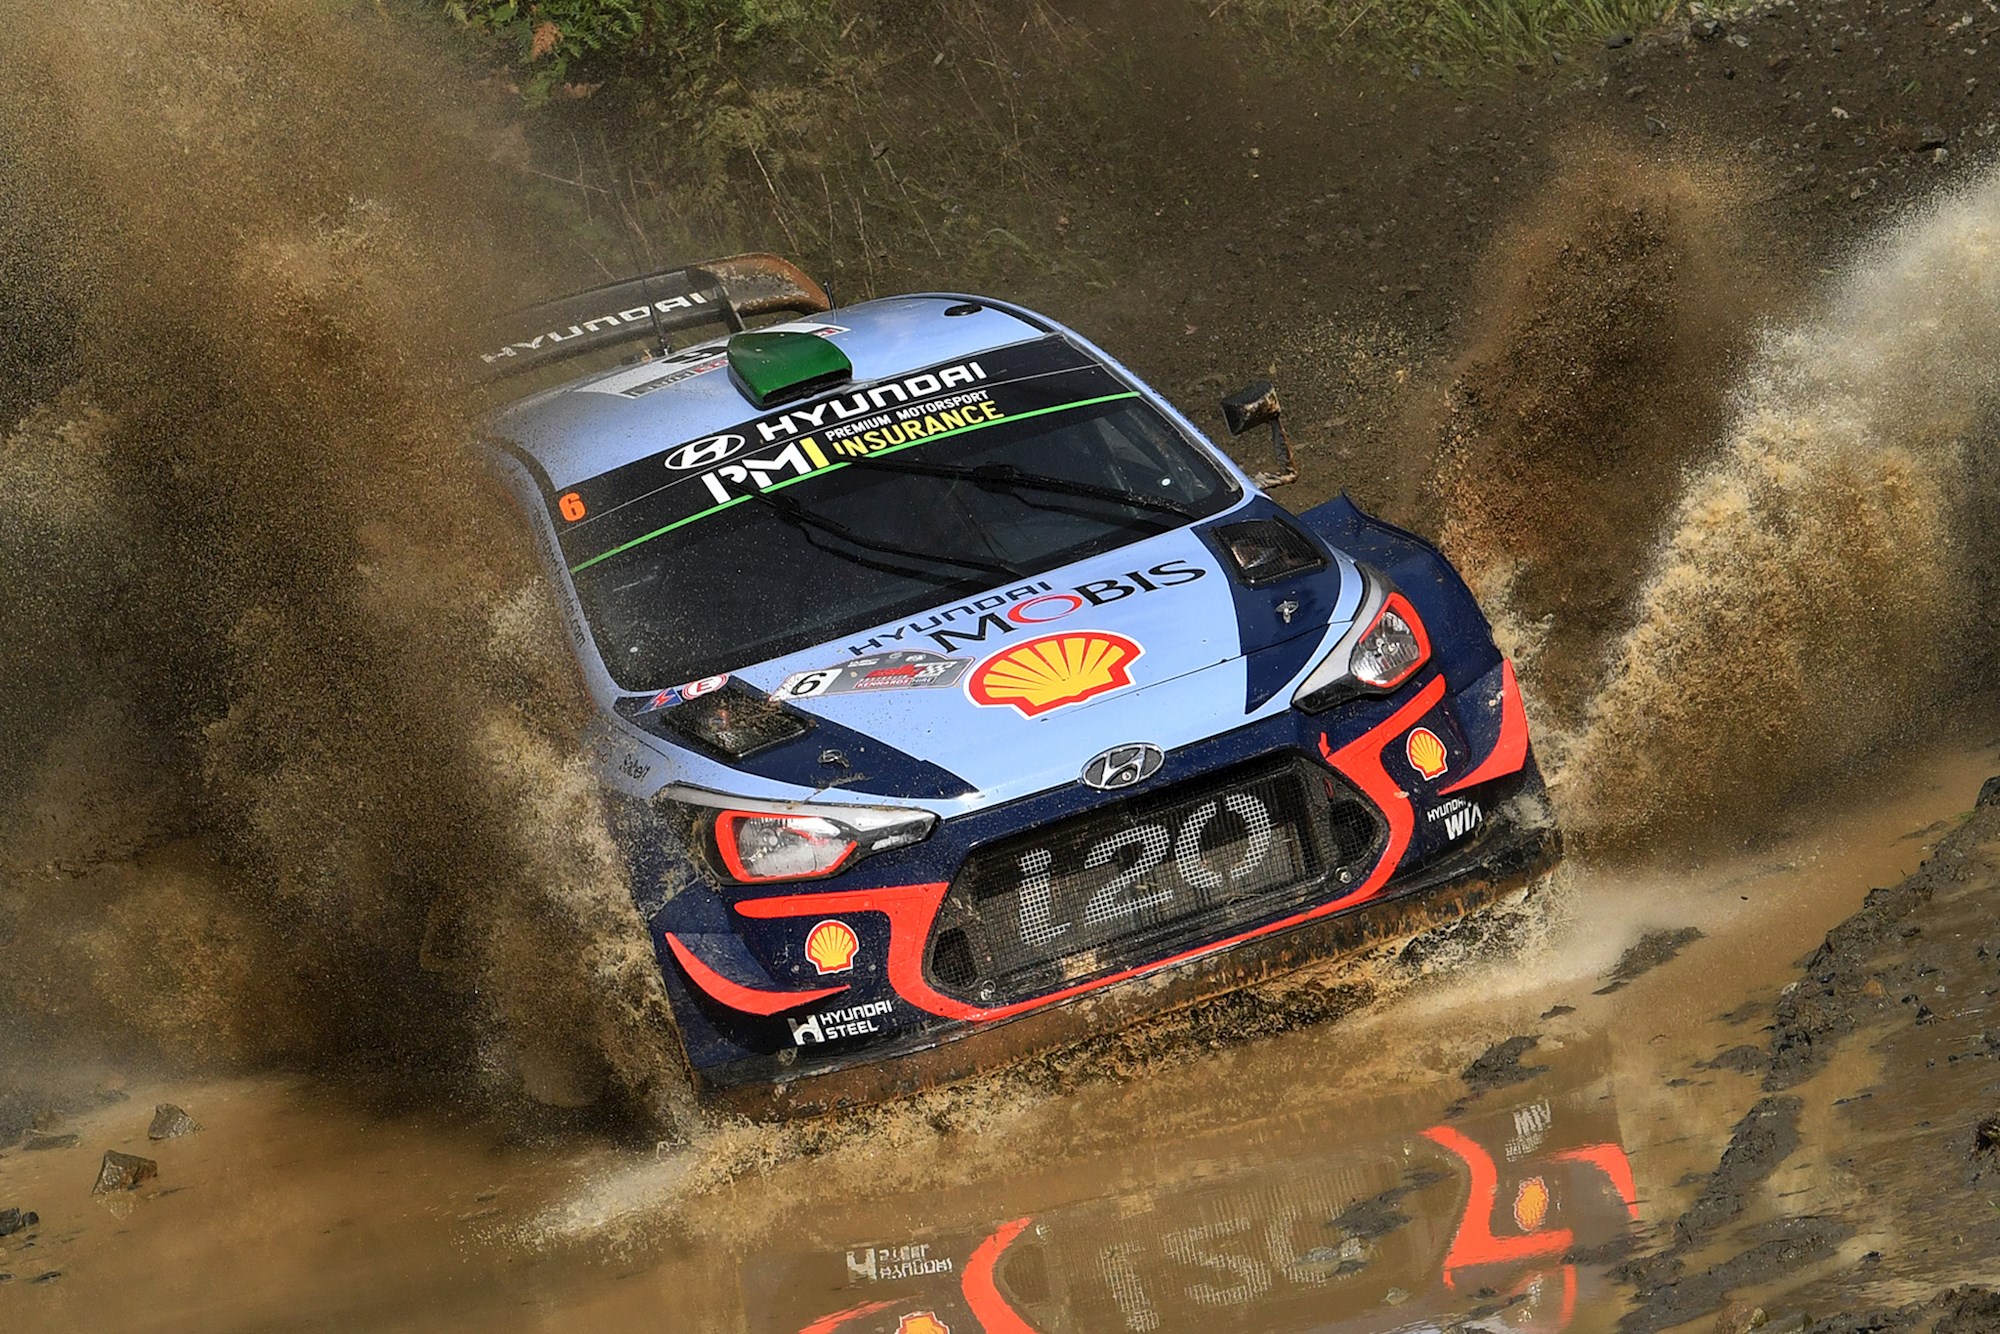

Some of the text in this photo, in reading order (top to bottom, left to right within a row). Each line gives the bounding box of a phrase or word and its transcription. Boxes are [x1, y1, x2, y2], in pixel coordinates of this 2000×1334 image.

[480, 292, 707, 363] HYUNDAI
[756, 361, 988, 442] HYUNDAI
[825, 389, 990, 442] PREMIUM MOTORSPORT
[832, 400, 1004, 457] INSURANCE
[701, 437, 830, 504] PMI
[559, 492, 586, 522] 6
[848, 581, 1054, 656] HYUNDAI
[924, 559, 1207, 653] MOBIS
[791, 672, 827, 695] 6
[1426, 796, 1468, 822] HYUNDAI
[1444, 801, 1483, 840] WIA
[820, 999, 893, 1026] HYUNDAI
[825, 1020, 880, 1040] STEEL
